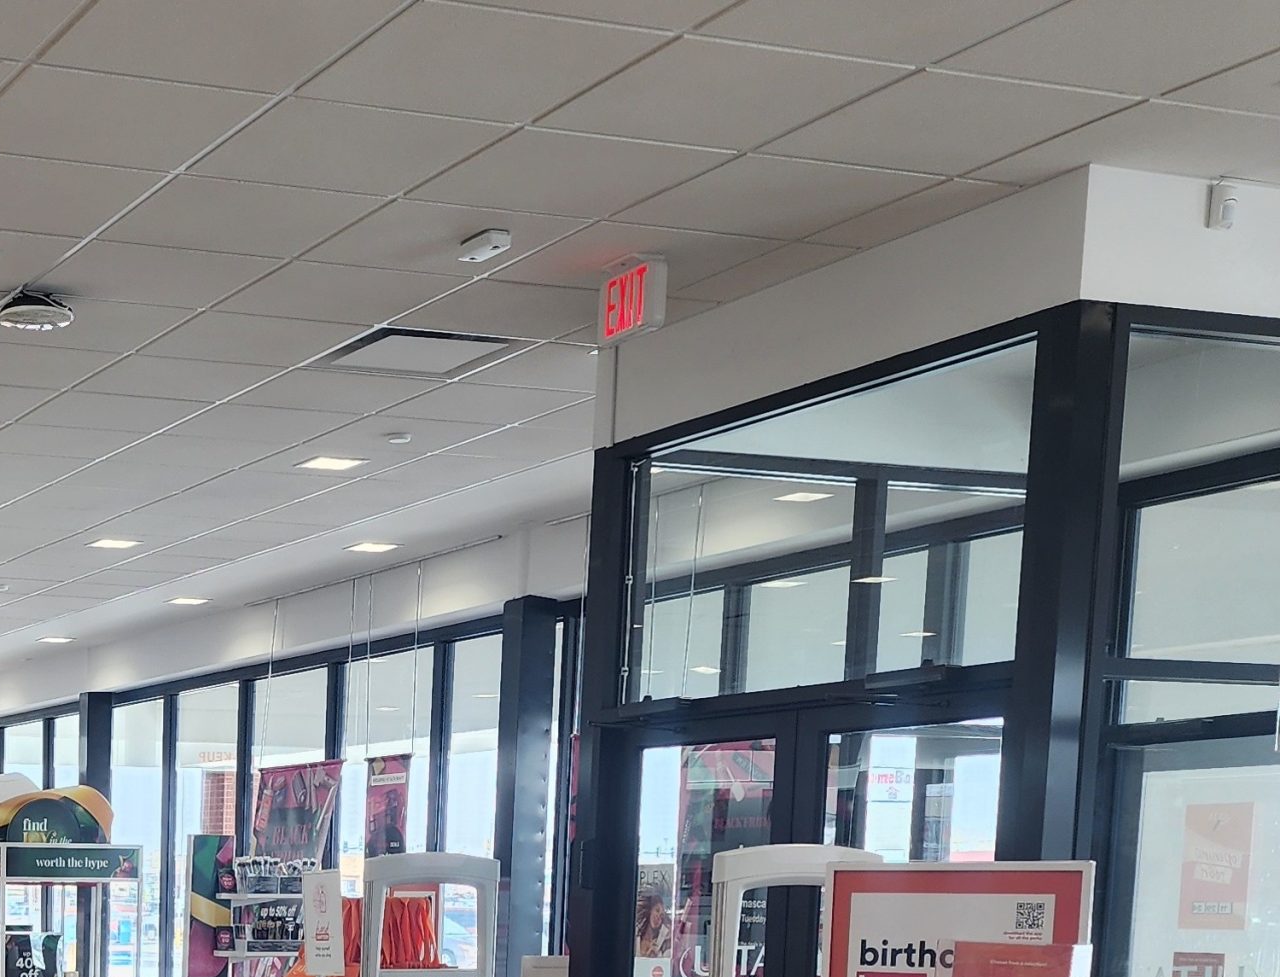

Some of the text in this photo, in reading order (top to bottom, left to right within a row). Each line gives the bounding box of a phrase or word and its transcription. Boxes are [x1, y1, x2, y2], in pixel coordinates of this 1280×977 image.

[605, 263, 648, 337] EXIT
[23, 819, 47, 831] find
[35, 856, 109, 869] worth the hype
[16, 958, 35, 969] 40
